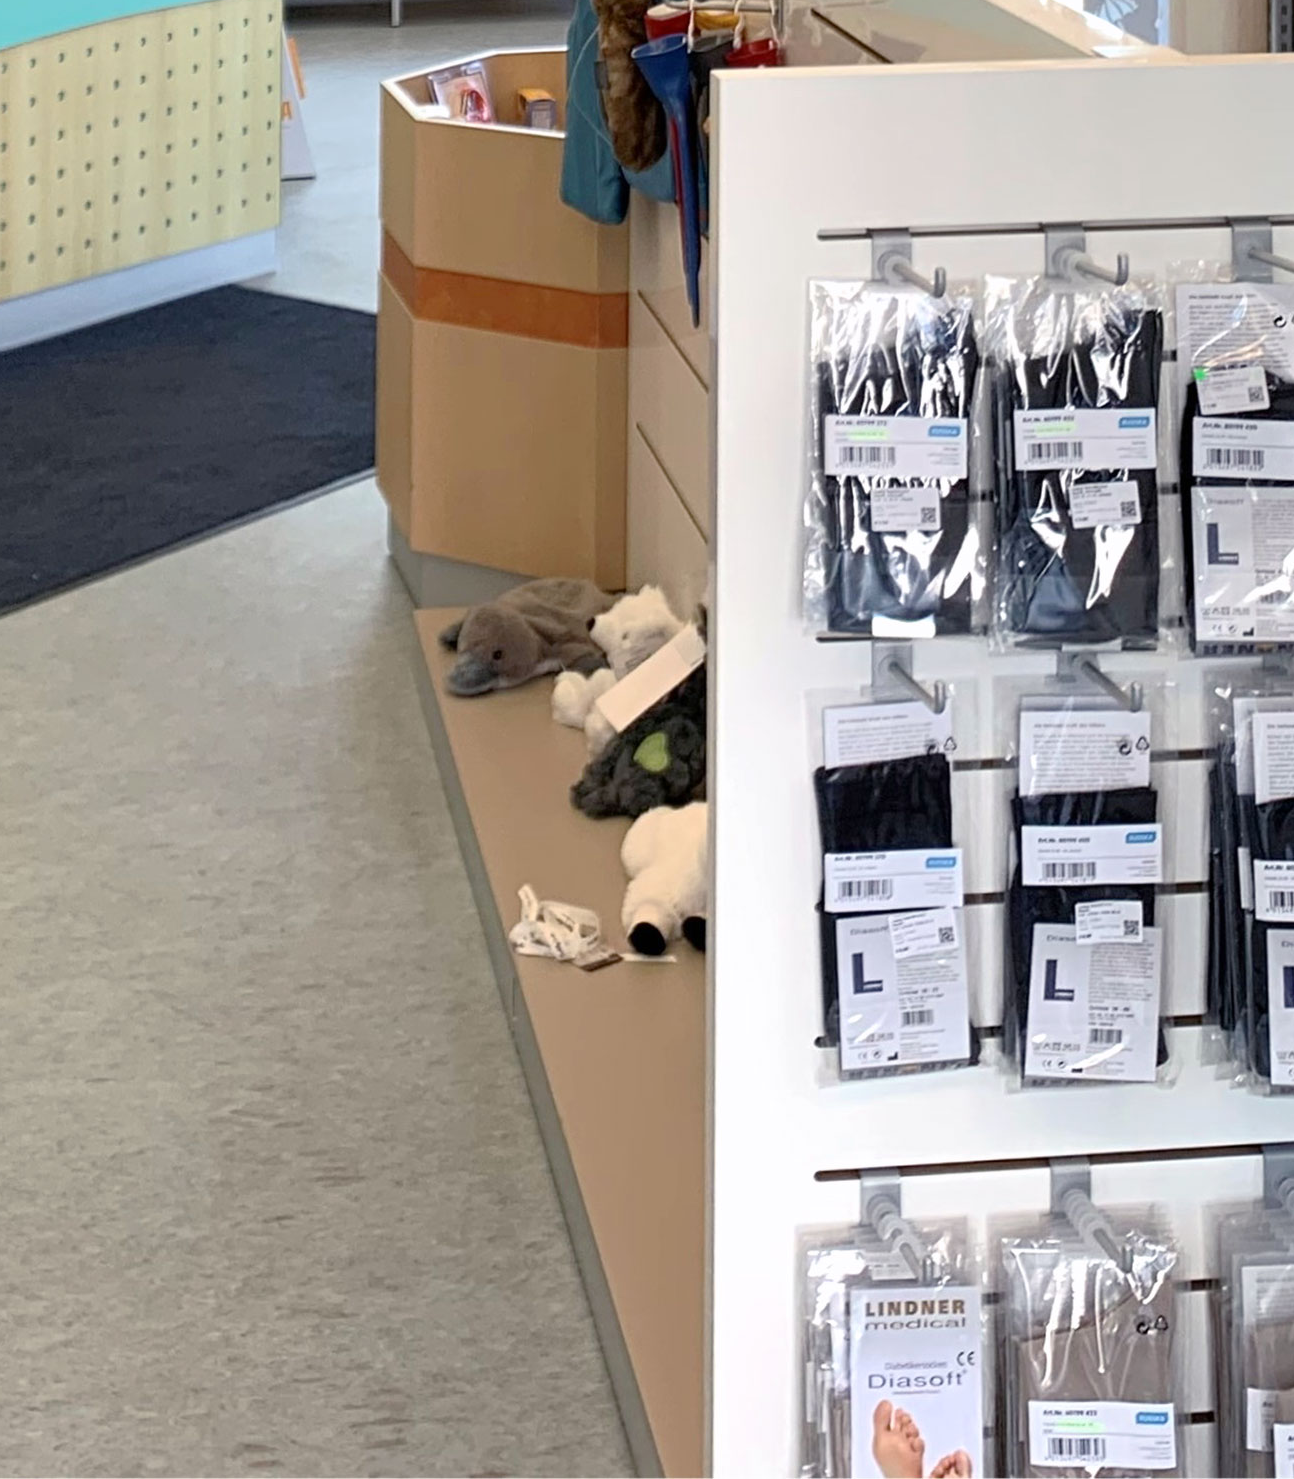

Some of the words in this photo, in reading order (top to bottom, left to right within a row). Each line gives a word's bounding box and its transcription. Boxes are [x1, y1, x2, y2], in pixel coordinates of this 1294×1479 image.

[1207, 523, 1239, 565] L
[852, 952, 883, 995] L
[1043, 959, 1075, 1001] L
[865, 1299, 966, 1317] LINDNER
[865, 1317, 966, 1331] medical
[868, 1371, 962, 1389] Diasoft
